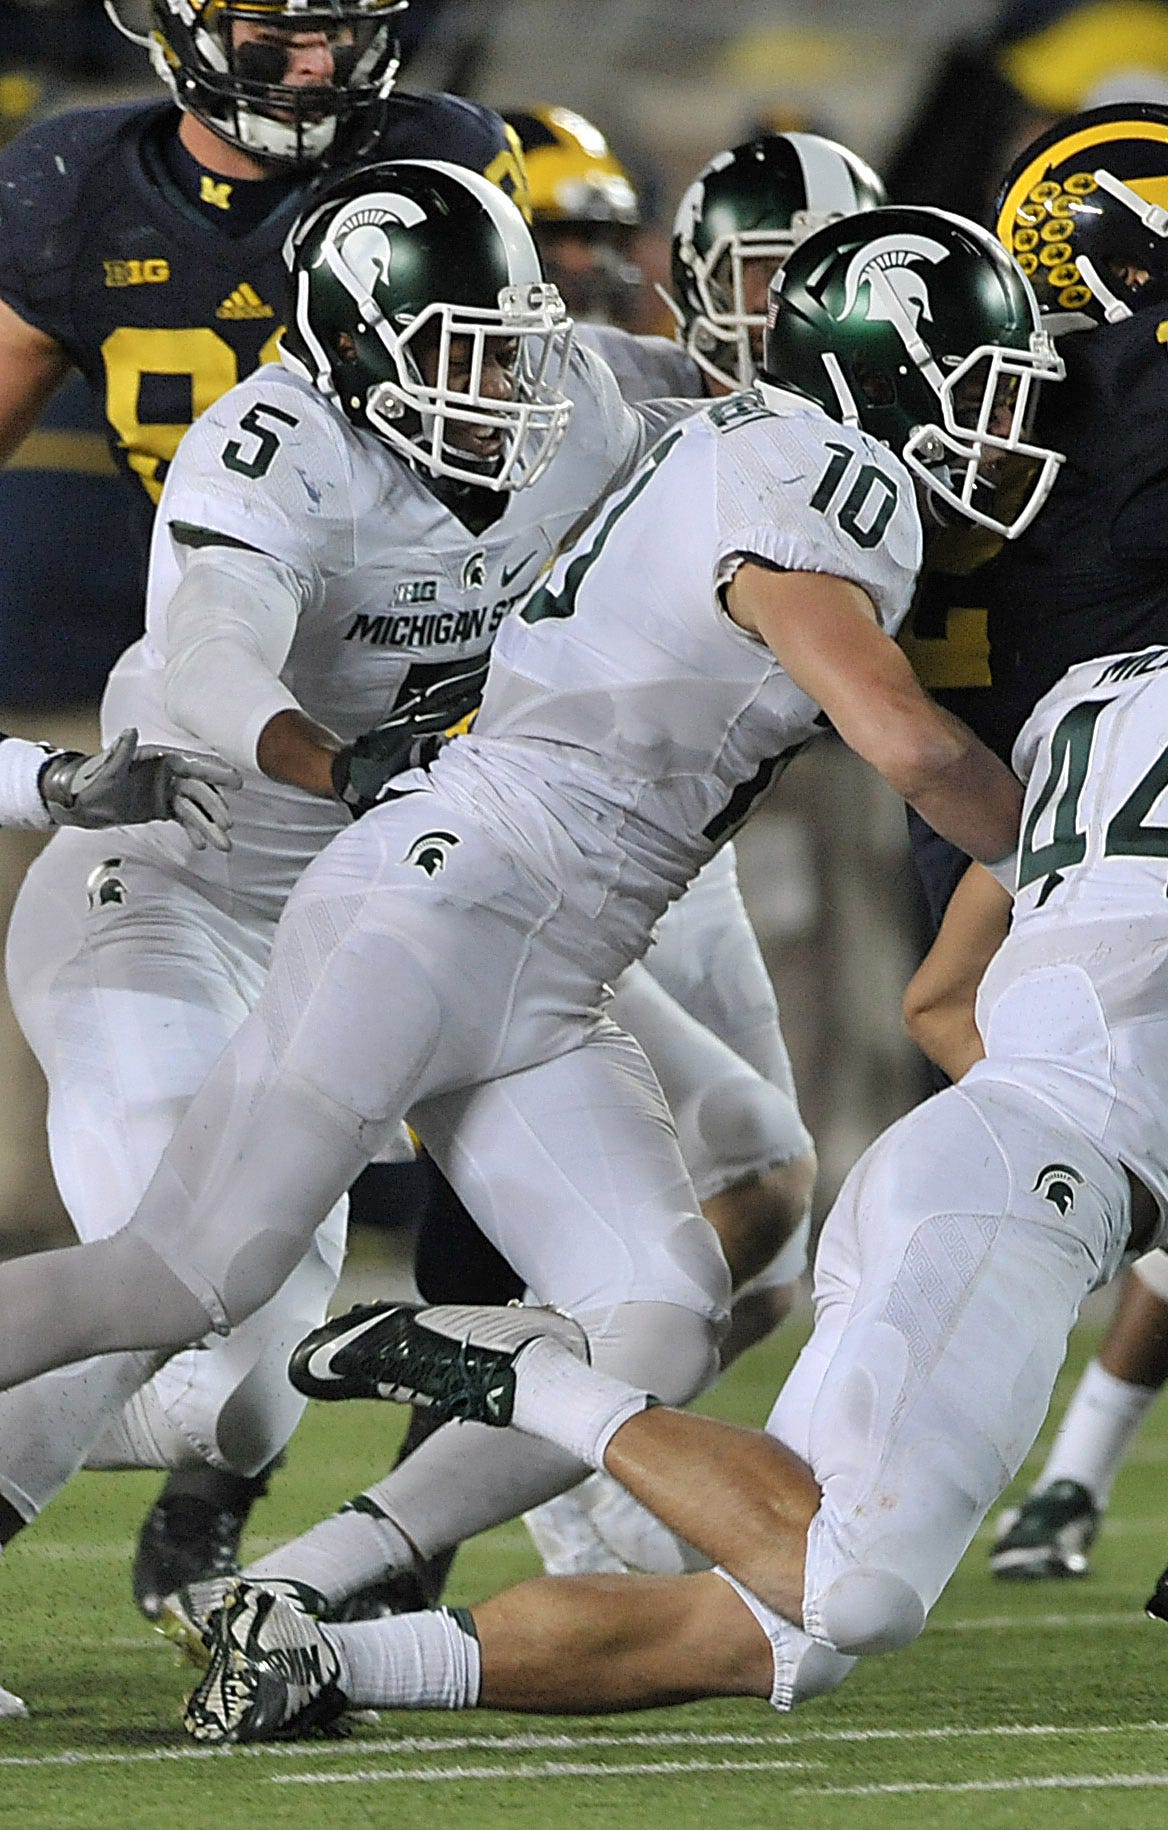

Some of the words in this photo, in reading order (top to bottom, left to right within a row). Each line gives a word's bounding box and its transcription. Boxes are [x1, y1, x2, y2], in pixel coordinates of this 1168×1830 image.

[221, 402, 300, 480] 5
[809, 441, 899, 549] 10
[344, 606, 487, 647] MICHIGAN
